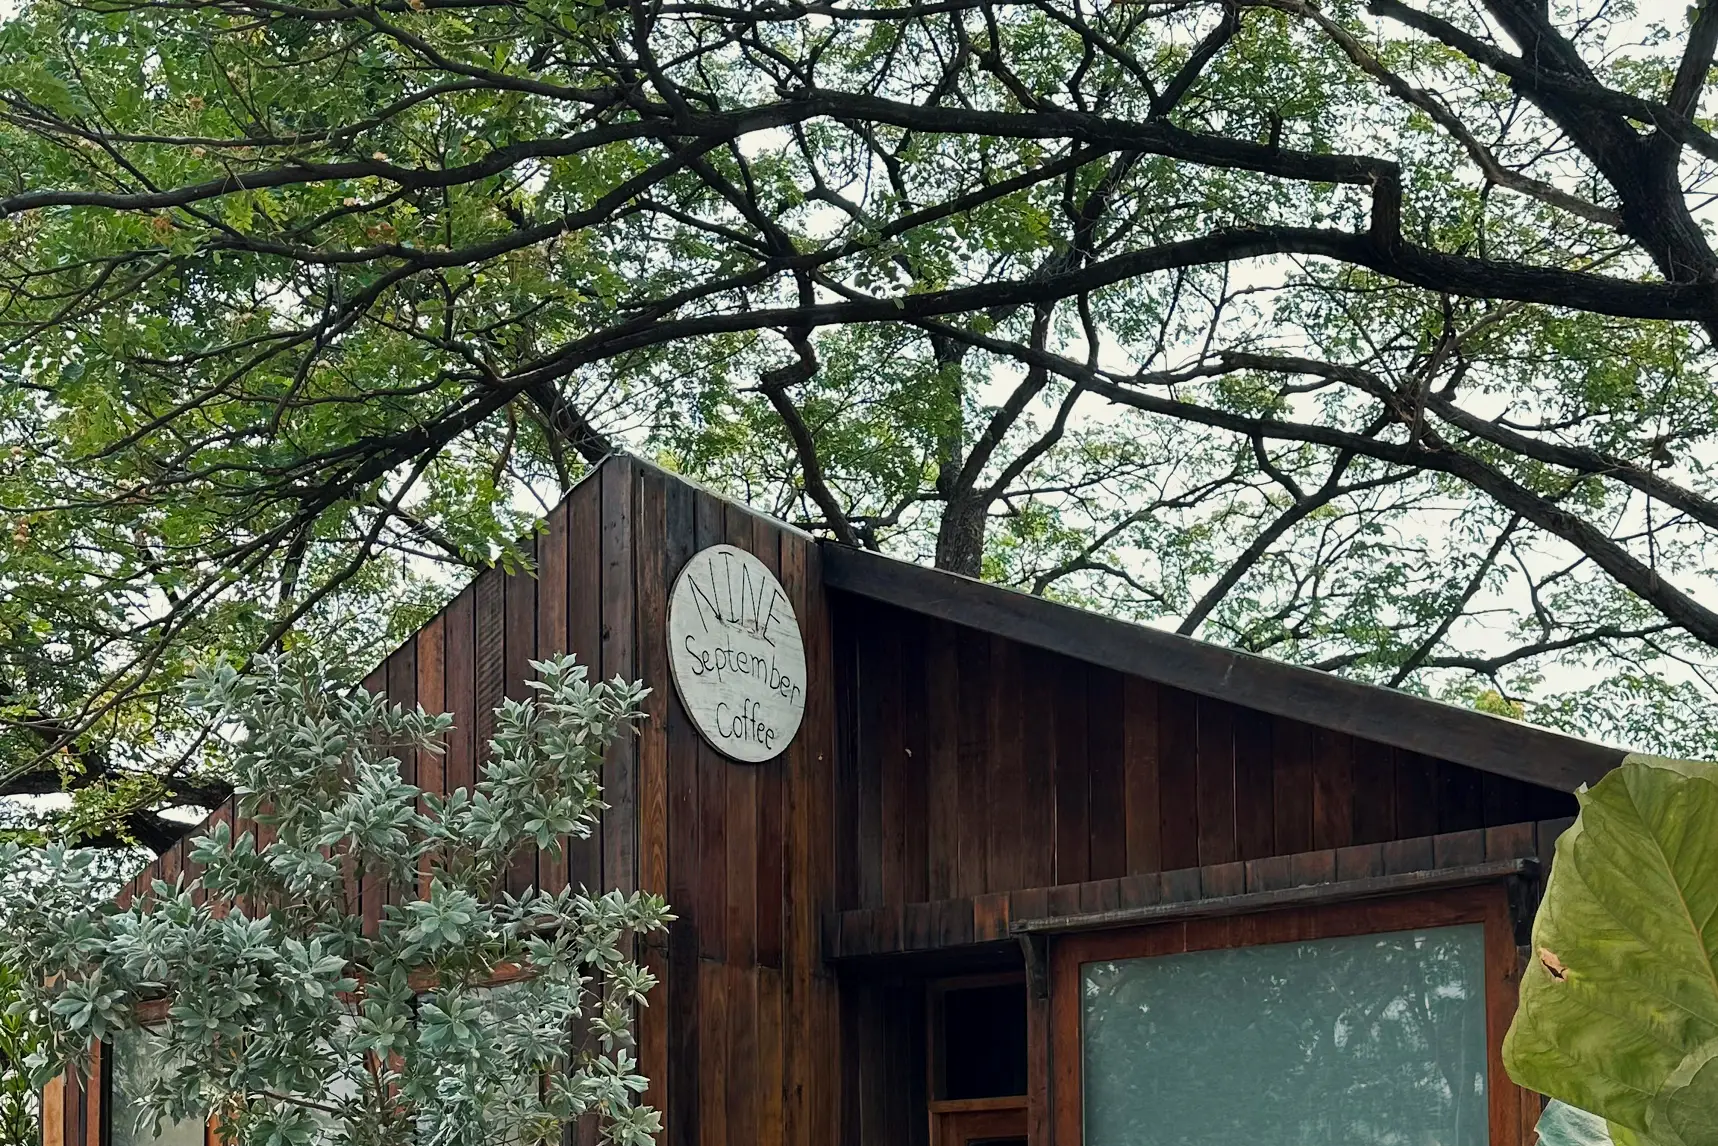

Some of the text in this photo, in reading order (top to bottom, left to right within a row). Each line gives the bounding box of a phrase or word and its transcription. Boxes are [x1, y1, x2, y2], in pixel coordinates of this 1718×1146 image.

[687, 551, 786, 647] NINE
[685, 634, 801, 705] September
[716, 698, 775, 750] Coffee
